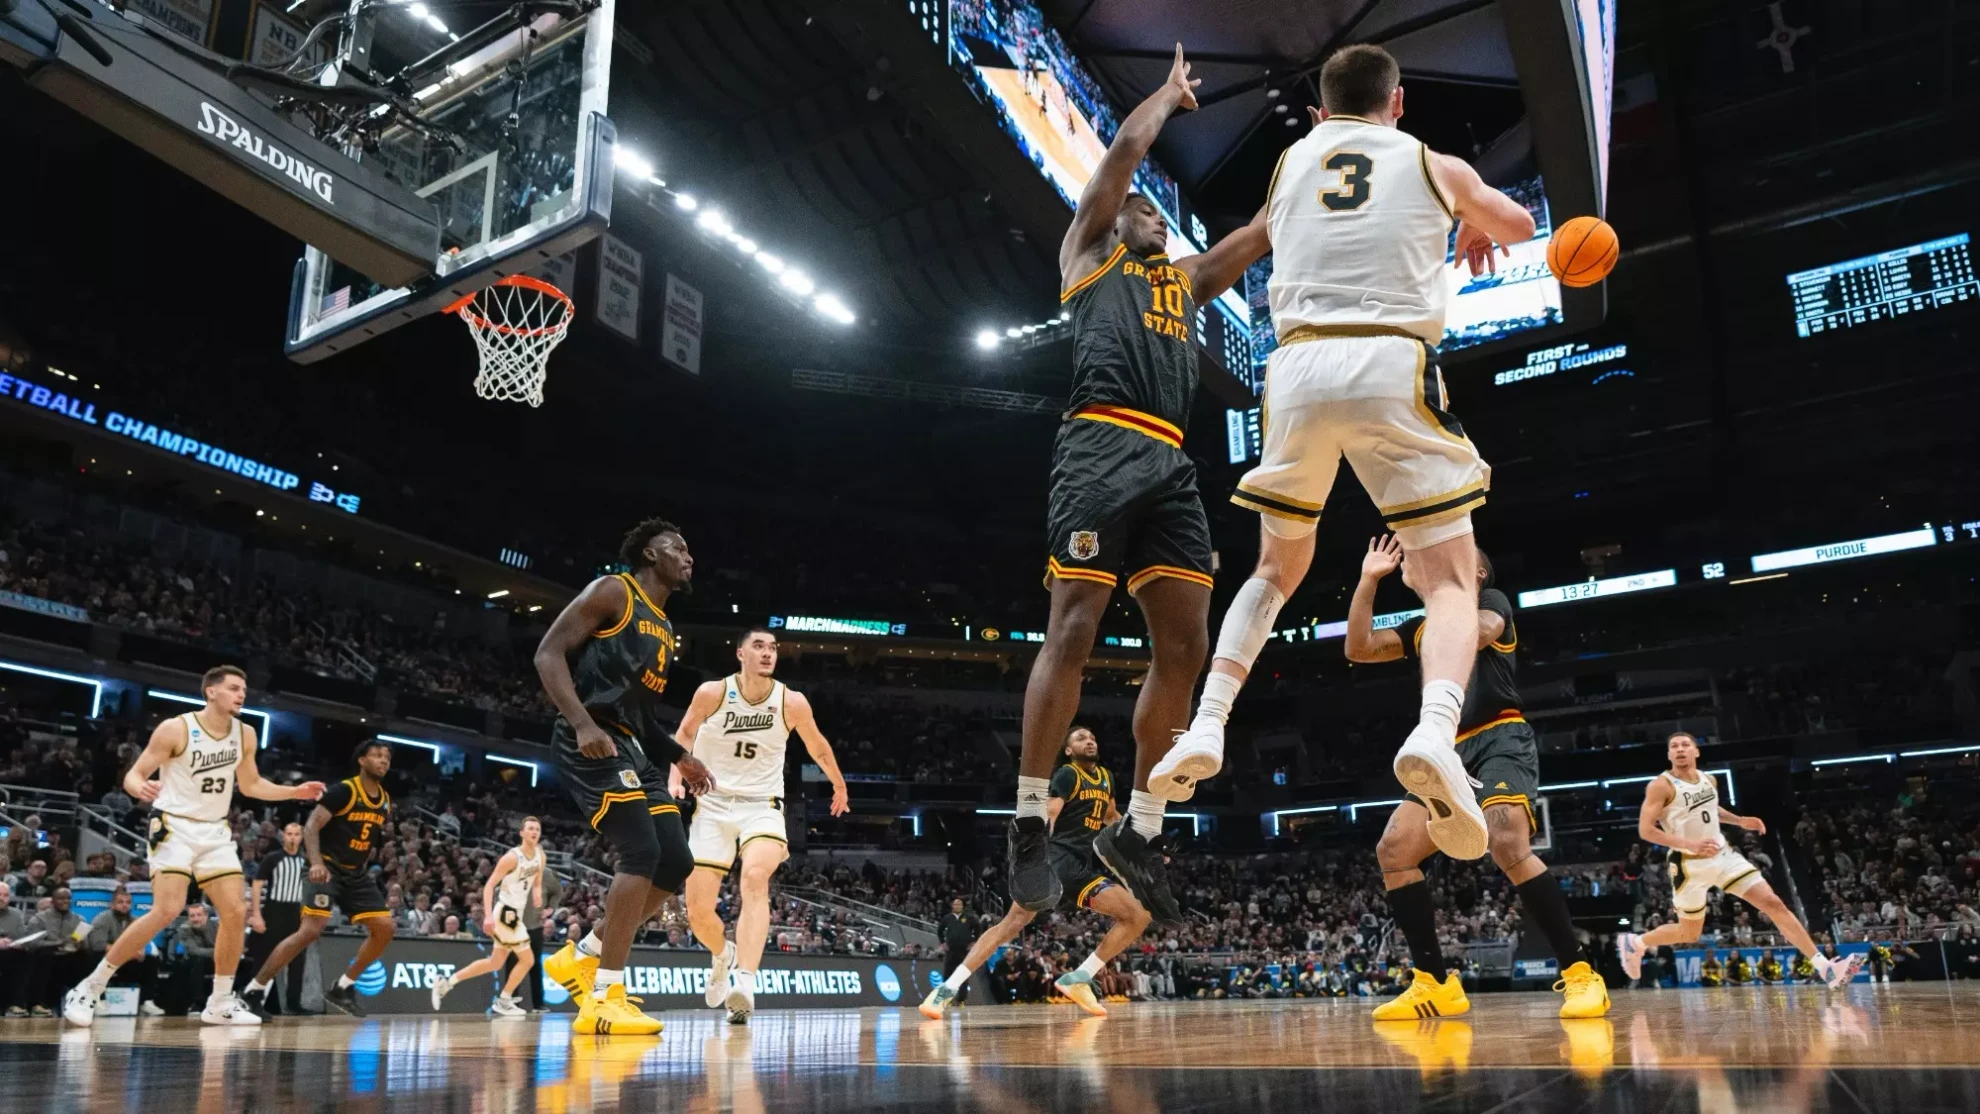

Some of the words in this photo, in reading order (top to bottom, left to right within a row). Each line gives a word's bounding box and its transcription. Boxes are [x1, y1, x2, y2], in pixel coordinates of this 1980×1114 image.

[198, 102, 334, 205] SPALDING
[1317, 149, 1374, 213] 3
[1151, 283, 1184, 318] 10
[1143, 311, 1188, 342] STATE
[1494, 361, 1557, 386] SECOND
[1559, 344, 1627, 371] ROUNDS
[1527, 343, 1575, 366] FIRST
[105, 411, 299, 490] CHAMPIONSHIP
[1815, 541, 1868, 560] PURDUE
[1702, 562, 1725, 580] 52
[1561, 583, 1599, 600] 13:27
[657, 644, 667, 673] 4
[641, 669, 667, 694] STATE
[723, 711, 774, 735] Purdue
[190, 748, 238, 773] Purdue
[734, 741, 758, 760] 15
[201, 777, 226, 794] 23
[1091, 800, 1103, 818] 11
[1702, 810, 1711, 824] 0
[361, 823, 372, 840] 5
[392, 962, 455, 989] AT&T
